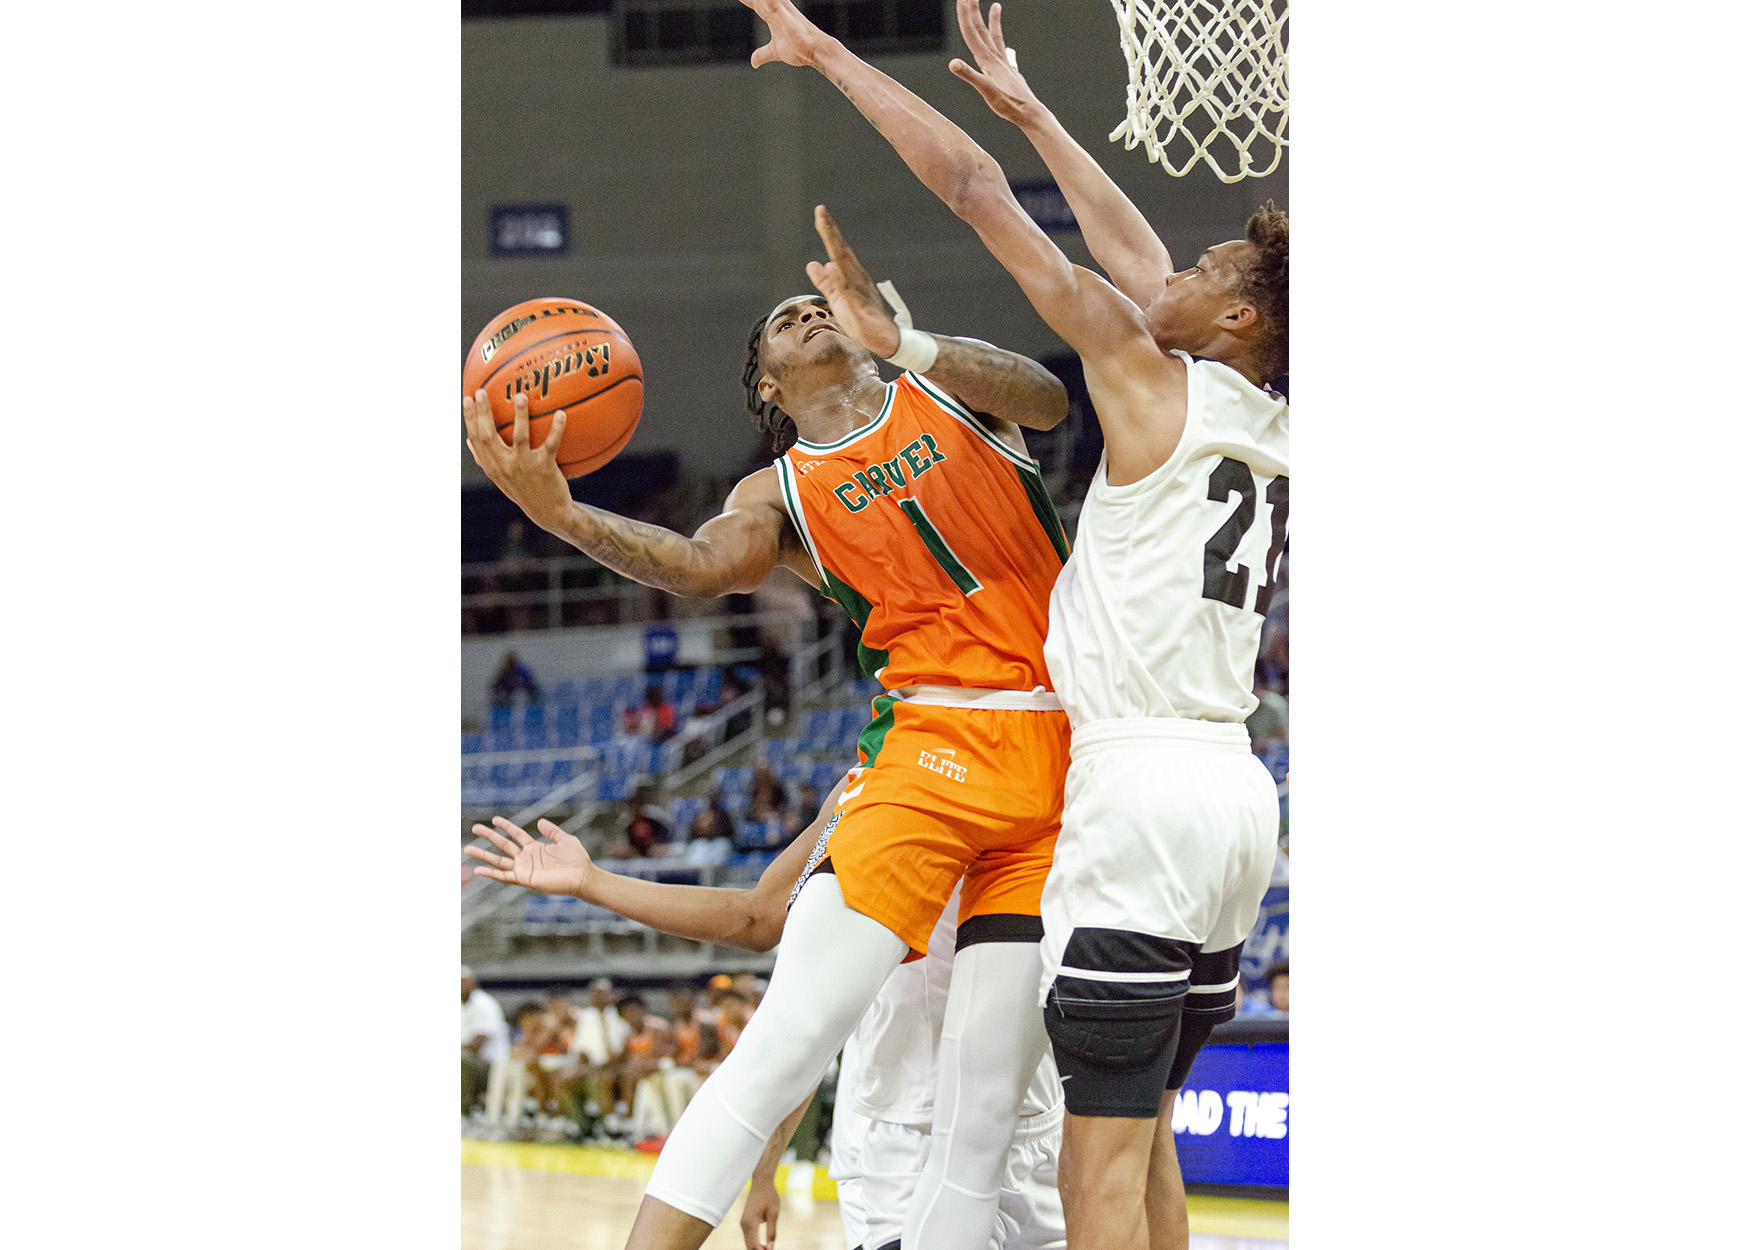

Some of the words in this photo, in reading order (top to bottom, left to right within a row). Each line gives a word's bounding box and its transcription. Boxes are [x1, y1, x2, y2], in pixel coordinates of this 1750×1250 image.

[505, 342, 610, 403] Baden
[833, 433, 947, 513] CARVER
[897, 495, 984, 597] 1
[1202, 456, 1289, 619] 21
[917, 749, 967, 783] ELITE
[1226, 1090, 1289, 1139] THE
